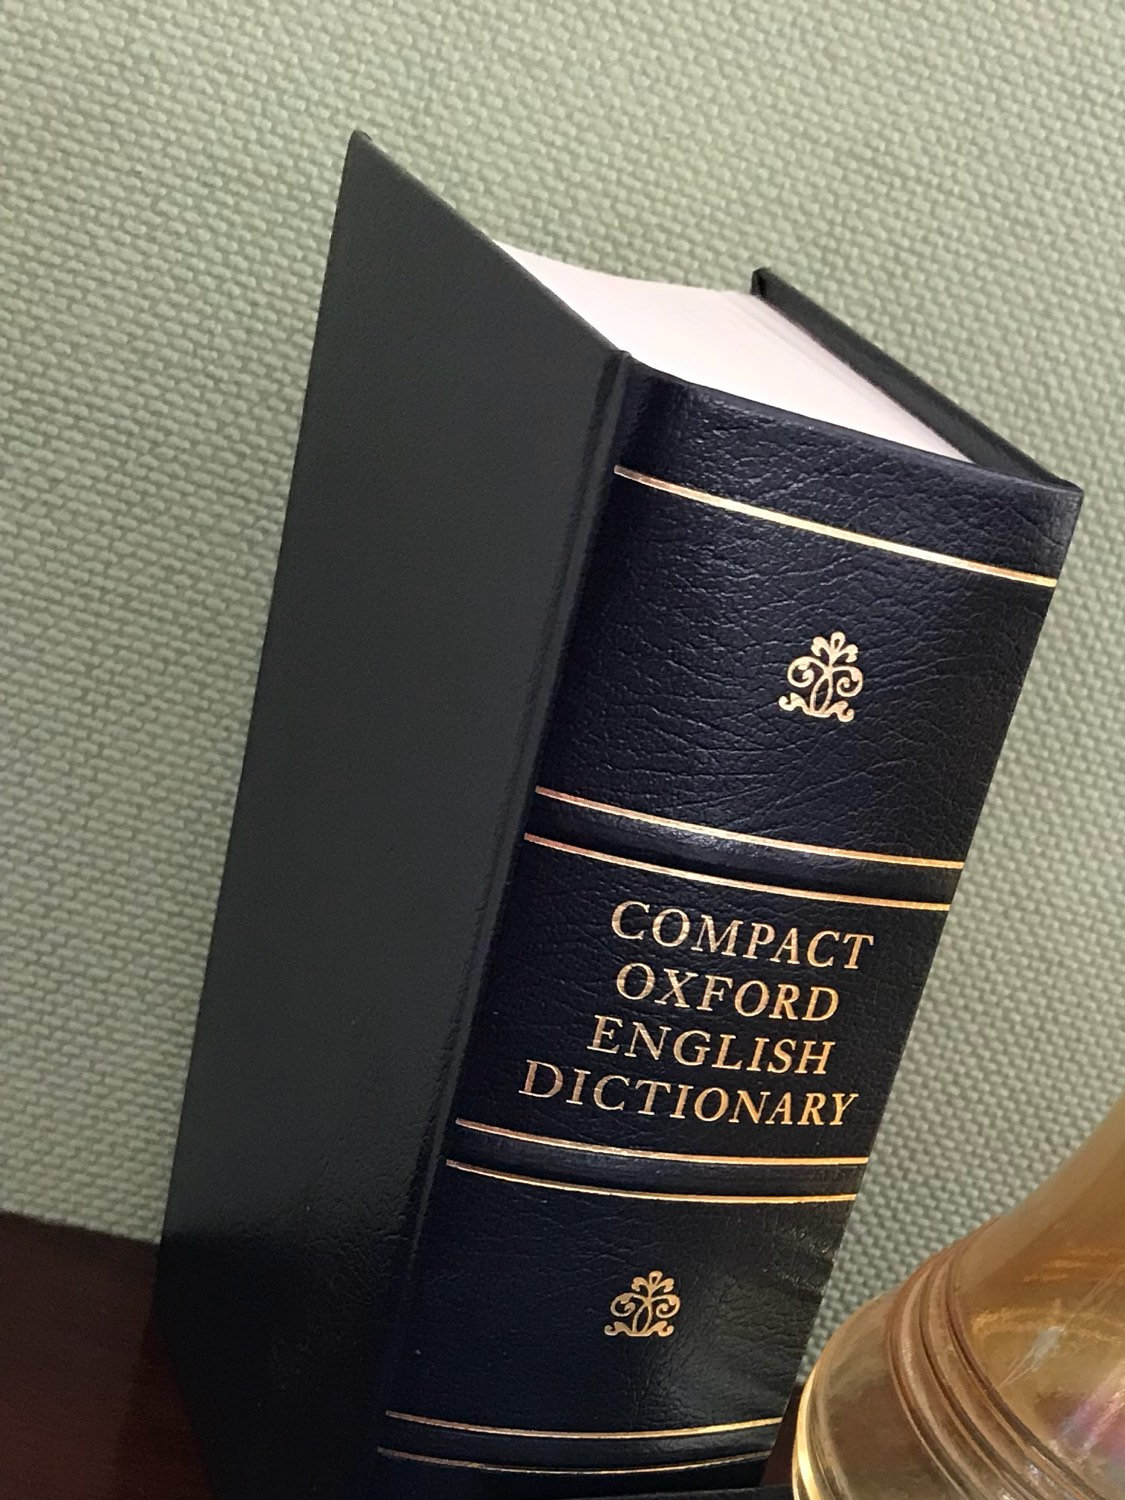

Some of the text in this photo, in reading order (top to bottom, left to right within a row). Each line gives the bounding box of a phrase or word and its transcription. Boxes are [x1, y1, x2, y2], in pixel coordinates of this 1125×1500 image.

[610, 900, 875, 970] COMPACT
[616, 961, 840, 1022] OXFORD
[586, 1014, 836, 1075] ENGLISH
[518, 1058, 860, 1127] DICTIONARY
